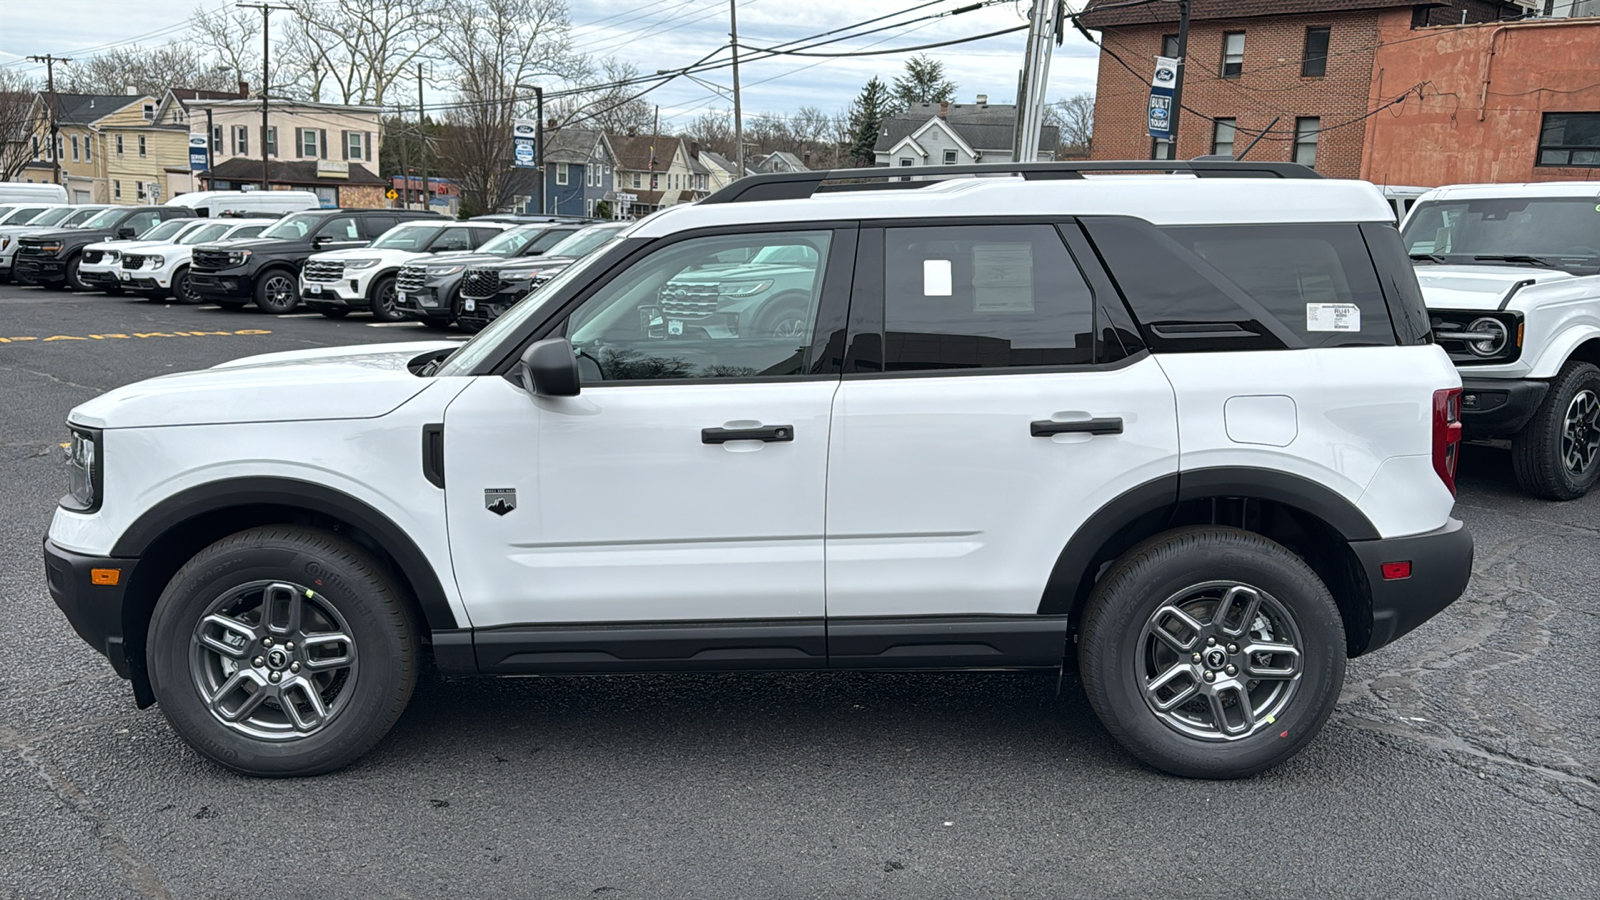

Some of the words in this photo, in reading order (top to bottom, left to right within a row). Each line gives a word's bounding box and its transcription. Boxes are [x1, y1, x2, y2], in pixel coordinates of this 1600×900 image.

[1157, 69, 1172, 81] Ford
[1151, 97, 1169, 108] BUILT
[1152, 109, 1166, 118] Ford
[1150, 118, 1168, 128] TOUGH
[517, 125, 532, 133] Ford
[305, 561, 372, 616] Continental
